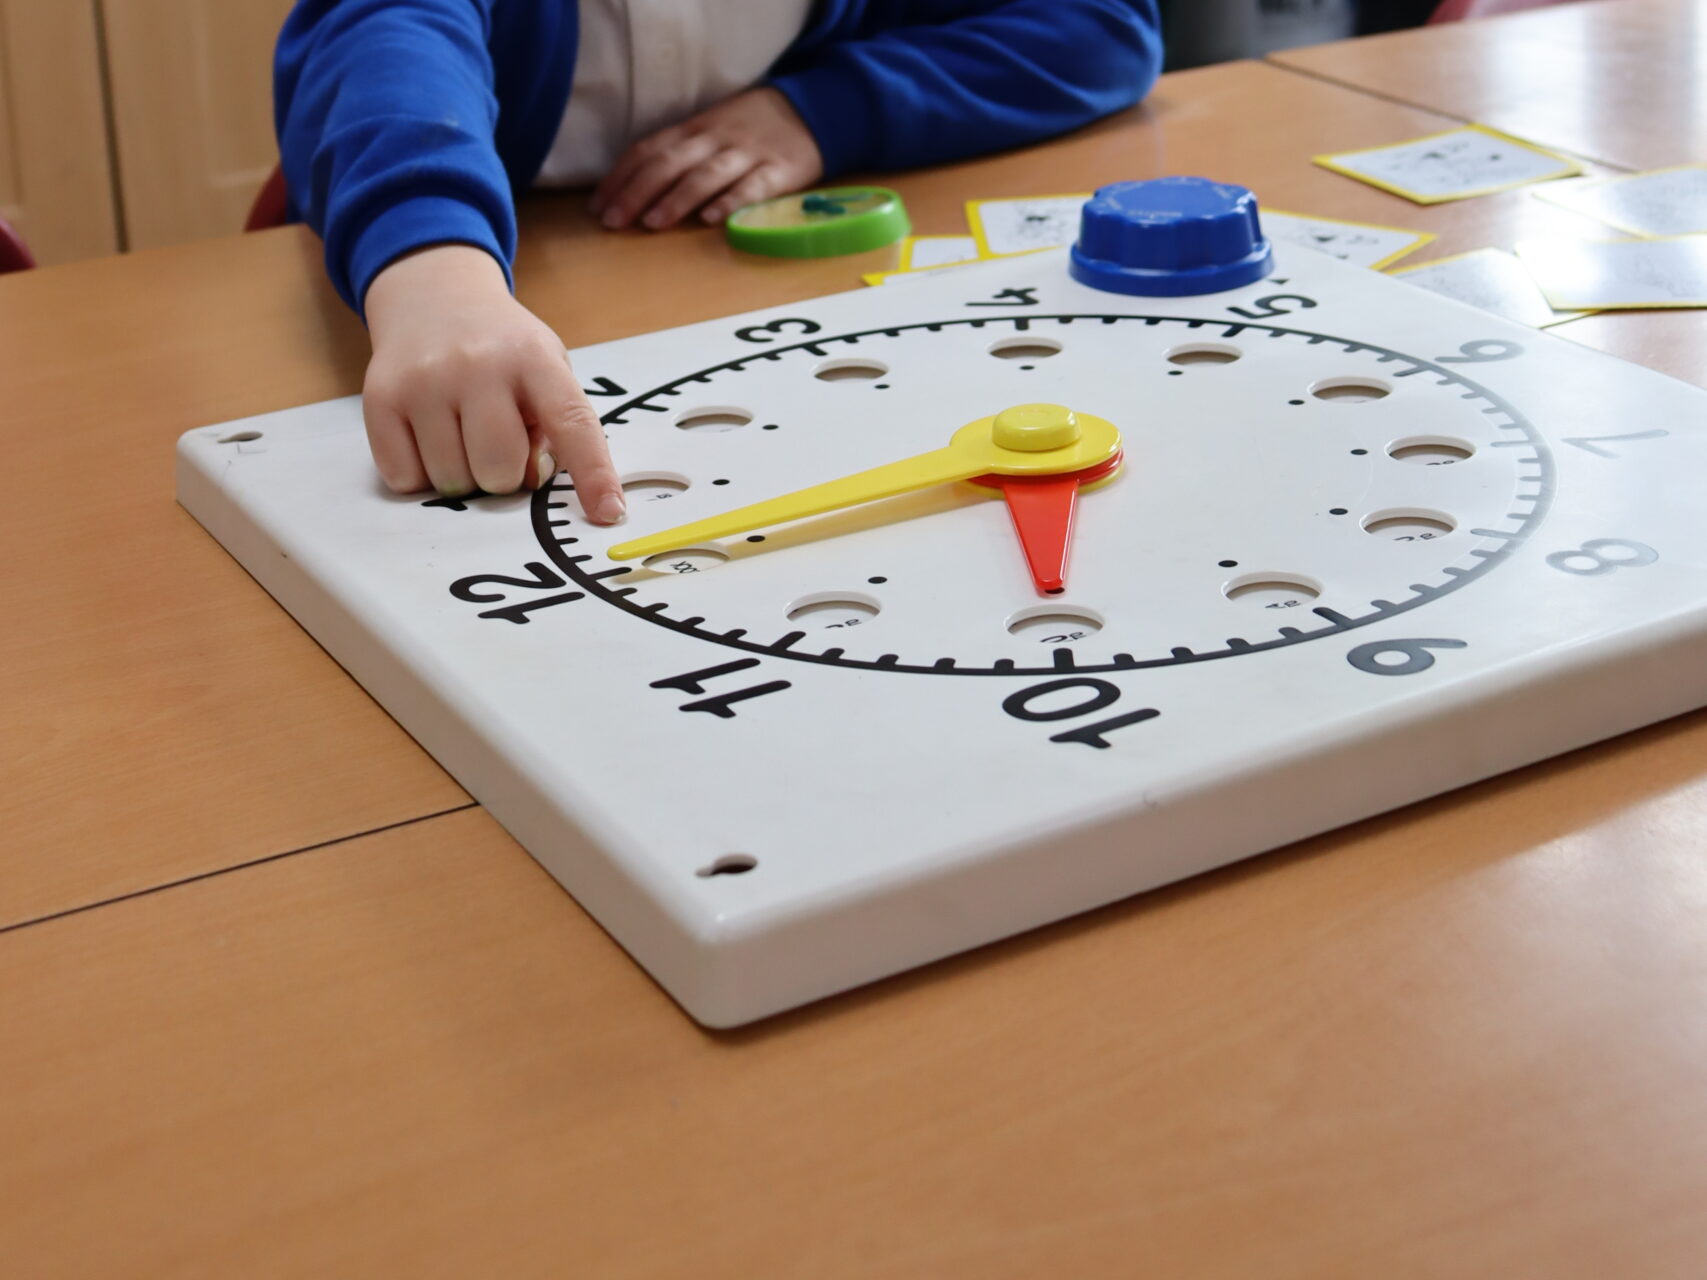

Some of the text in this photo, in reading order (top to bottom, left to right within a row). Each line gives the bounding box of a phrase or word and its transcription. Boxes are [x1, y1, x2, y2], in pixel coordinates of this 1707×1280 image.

[965, 287, 1040, 307] 4
[1227, 293, 1318, 320] 5
[734, 317, 822, 344] 3
[1433, 338, 1525, 365] 6
[1561, 428, 1670, 460] 7
[1545, 537, 1660, 577] 8
[448, 561, 586, 625] 12
[1345, 637, 1468, 677] 9
[648, 657, 792, 719] 11
[1001, 676, 1161, 750] 10
